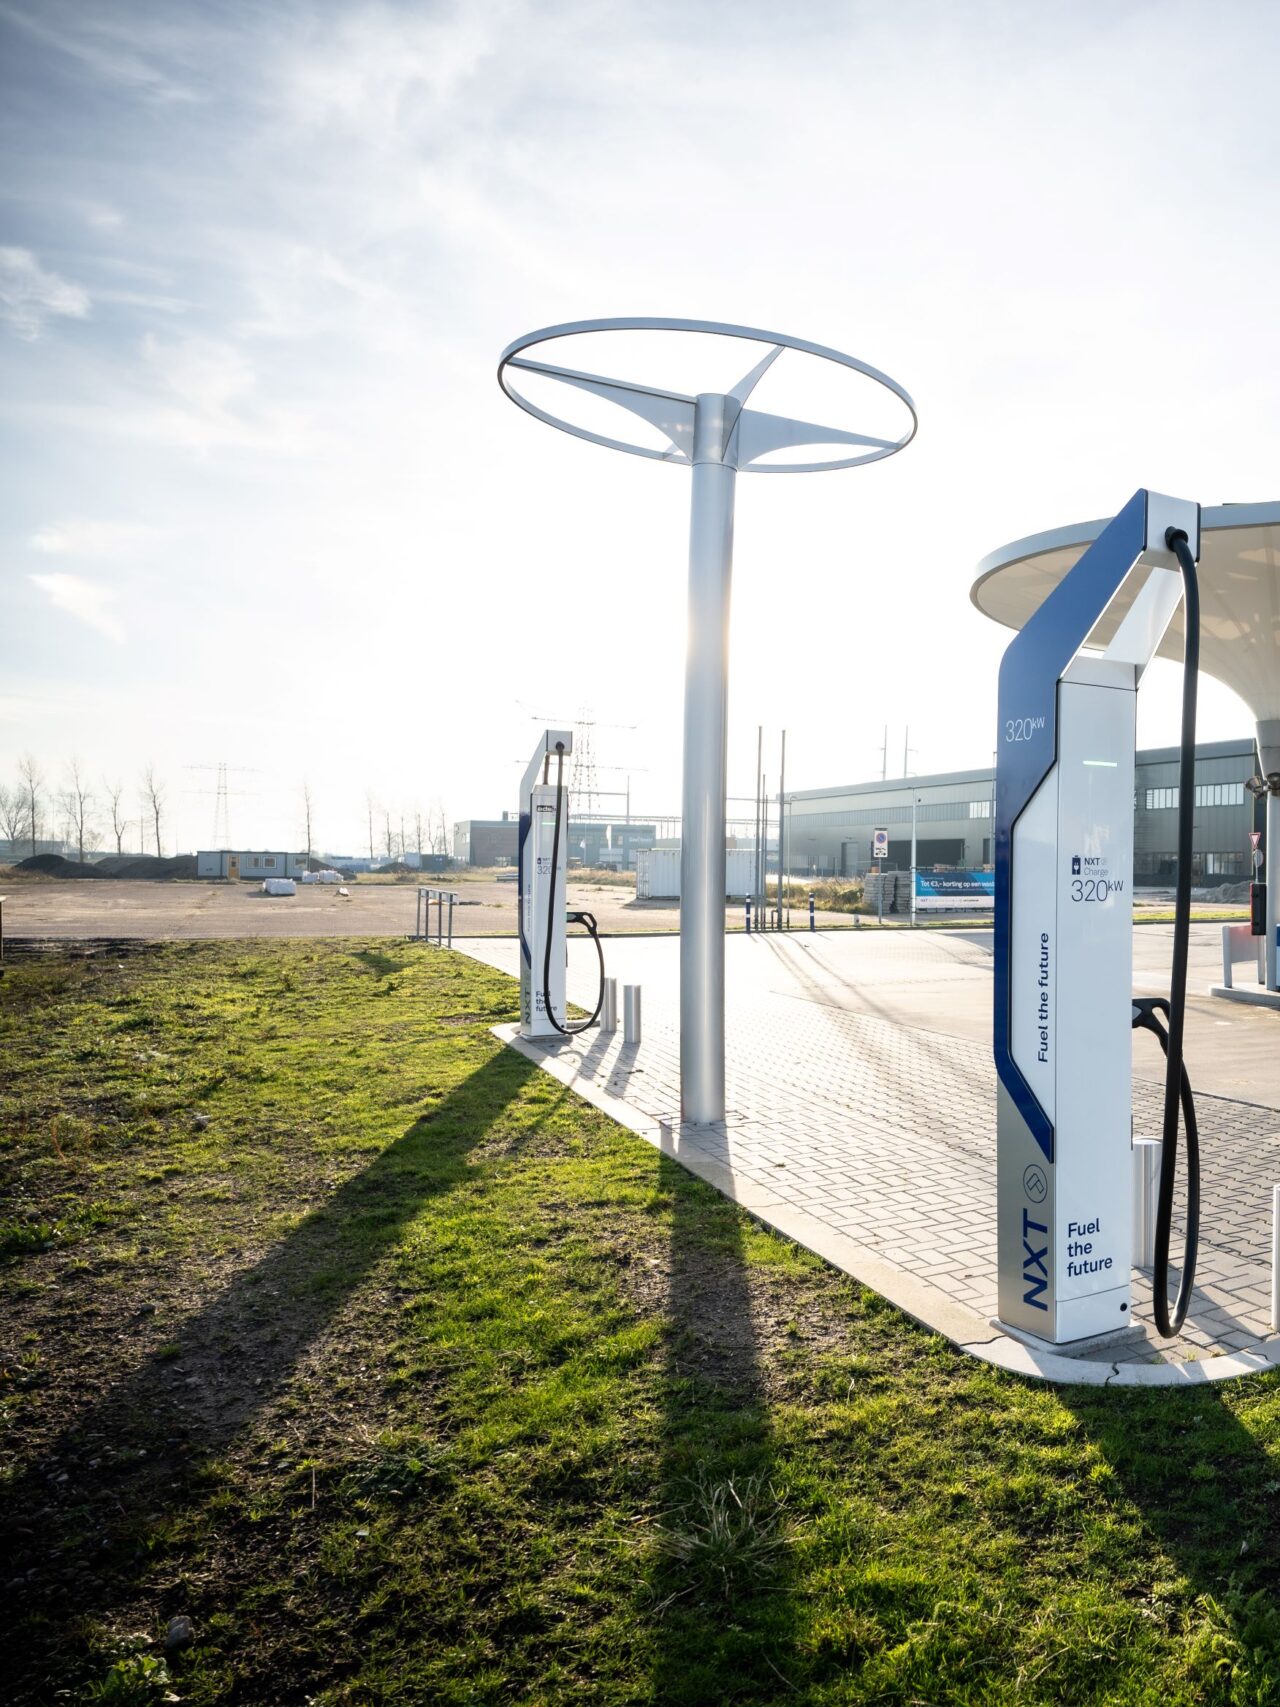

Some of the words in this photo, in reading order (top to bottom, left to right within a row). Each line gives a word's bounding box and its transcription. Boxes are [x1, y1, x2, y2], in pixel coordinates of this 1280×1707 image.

[1084, 857, 1101, 866] NXT
[1083, 867, 1109, 878] Charge
[942, 880, 963, 889] korting
[1038, 932, 1049, 988] future
[1038, 991, 1048, 1021] the
[1038, 1025, 1048, 1063] Fuel
[1067, 1217, 1100, 1238] Fuel
[1023, 1208, 1048, 1312] NXT
[1066, 1241, 1093, 1258] the
[1067, 1257, 1113, 1278] future
